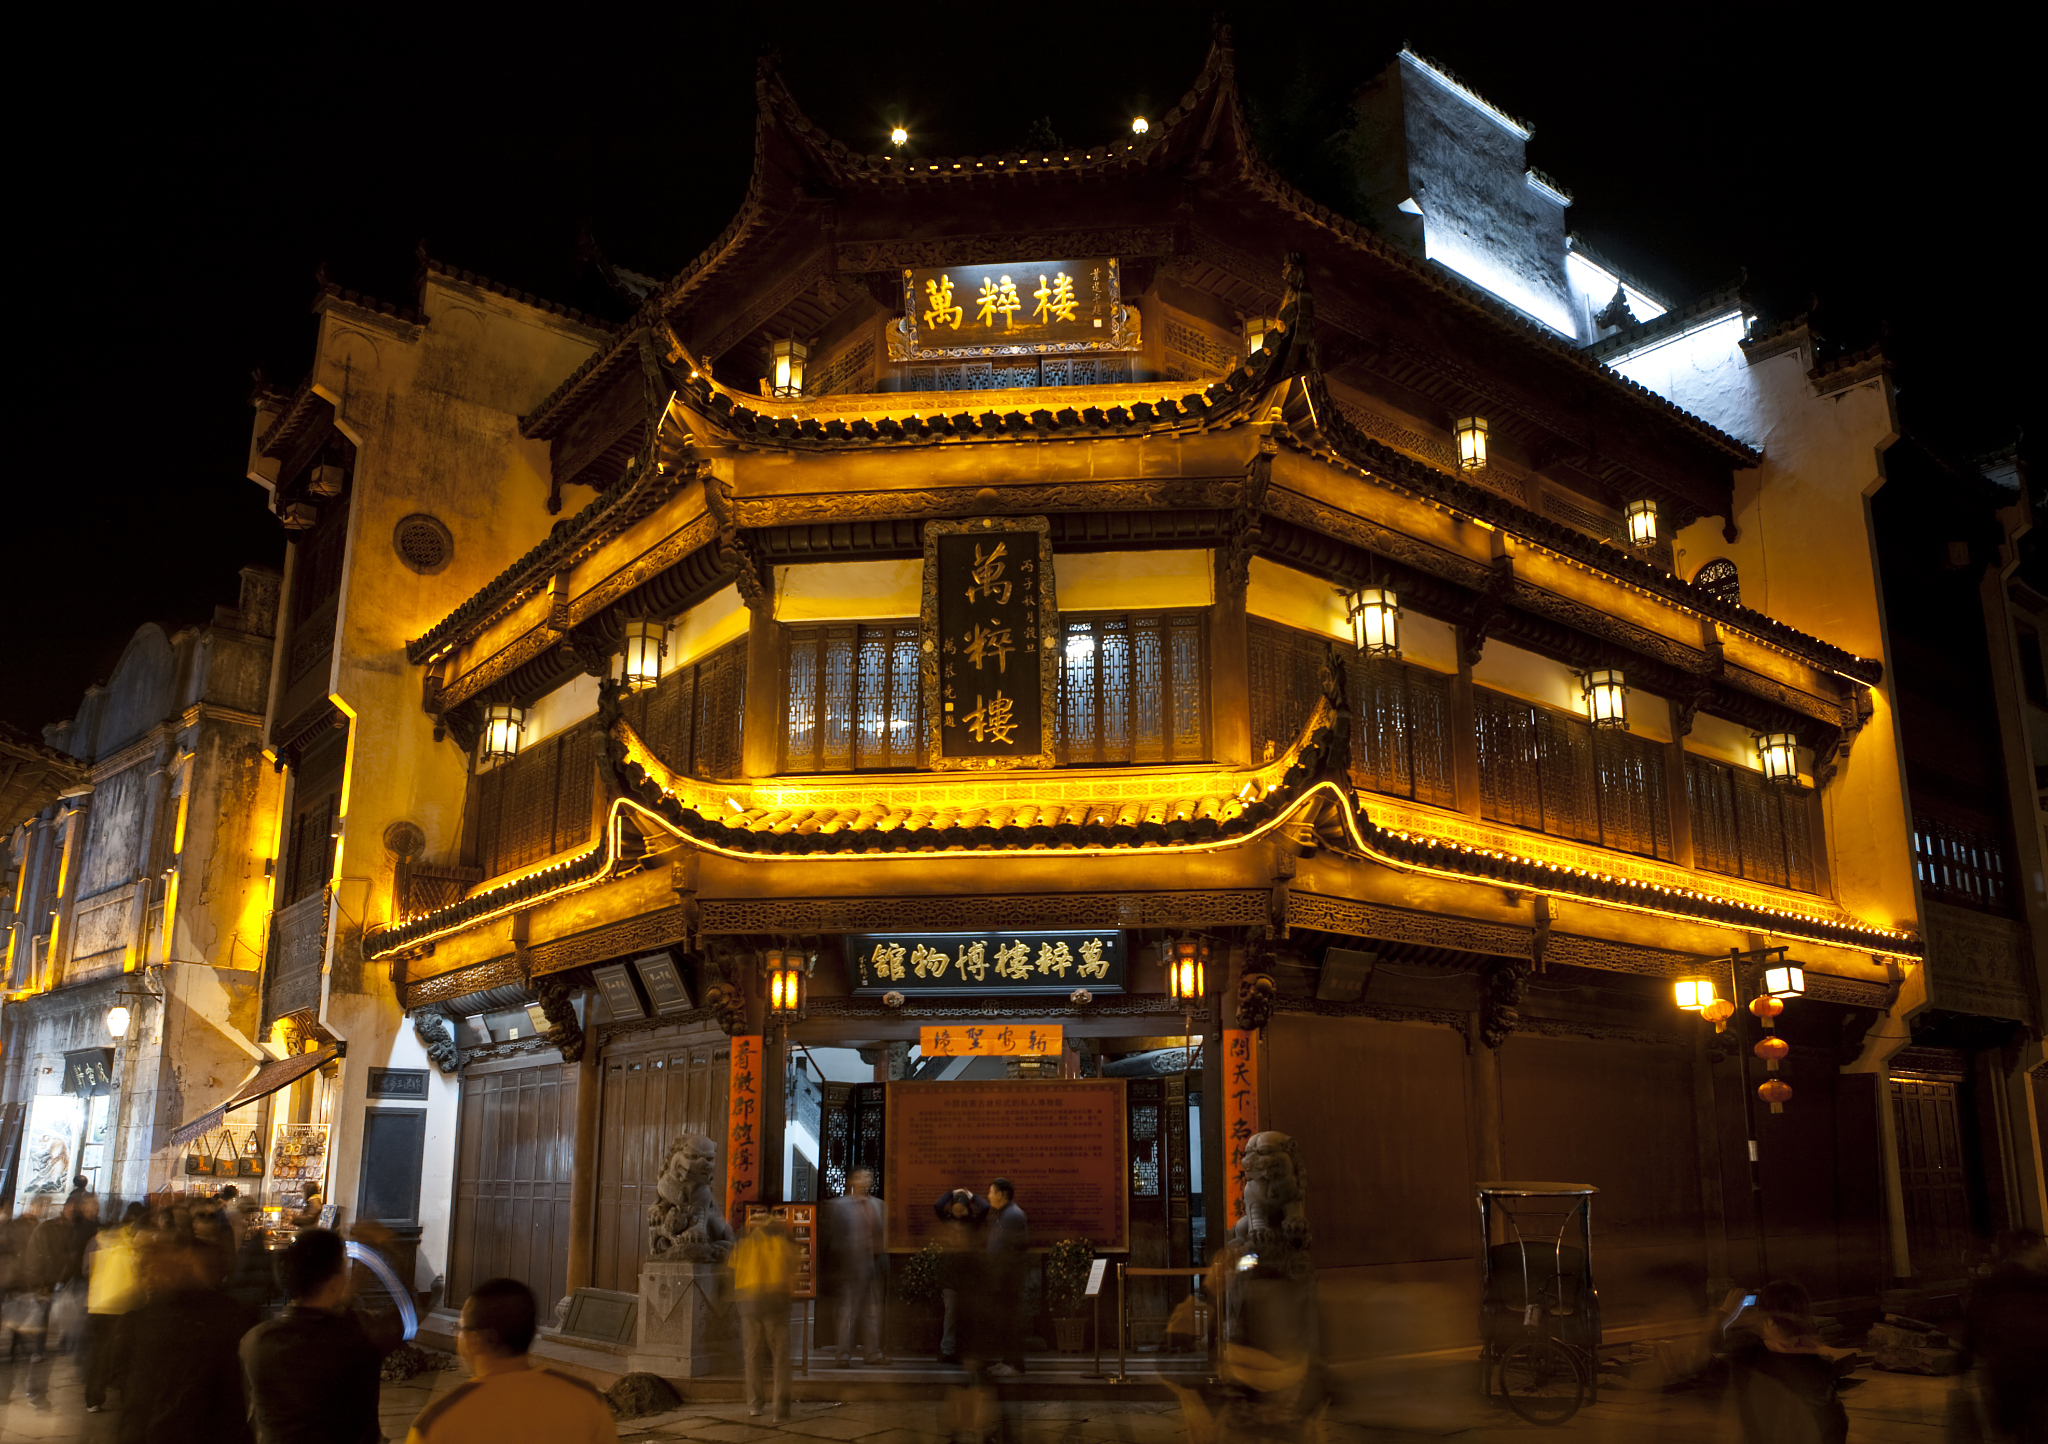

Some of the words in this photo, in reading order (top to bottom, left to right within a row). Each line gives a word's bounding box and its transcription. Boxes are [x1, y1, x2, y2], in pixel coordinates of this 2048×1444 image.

[923, 272, 1080, 331] 萬粹楼
[962, 541, 1018, 745] 萬粹樓
